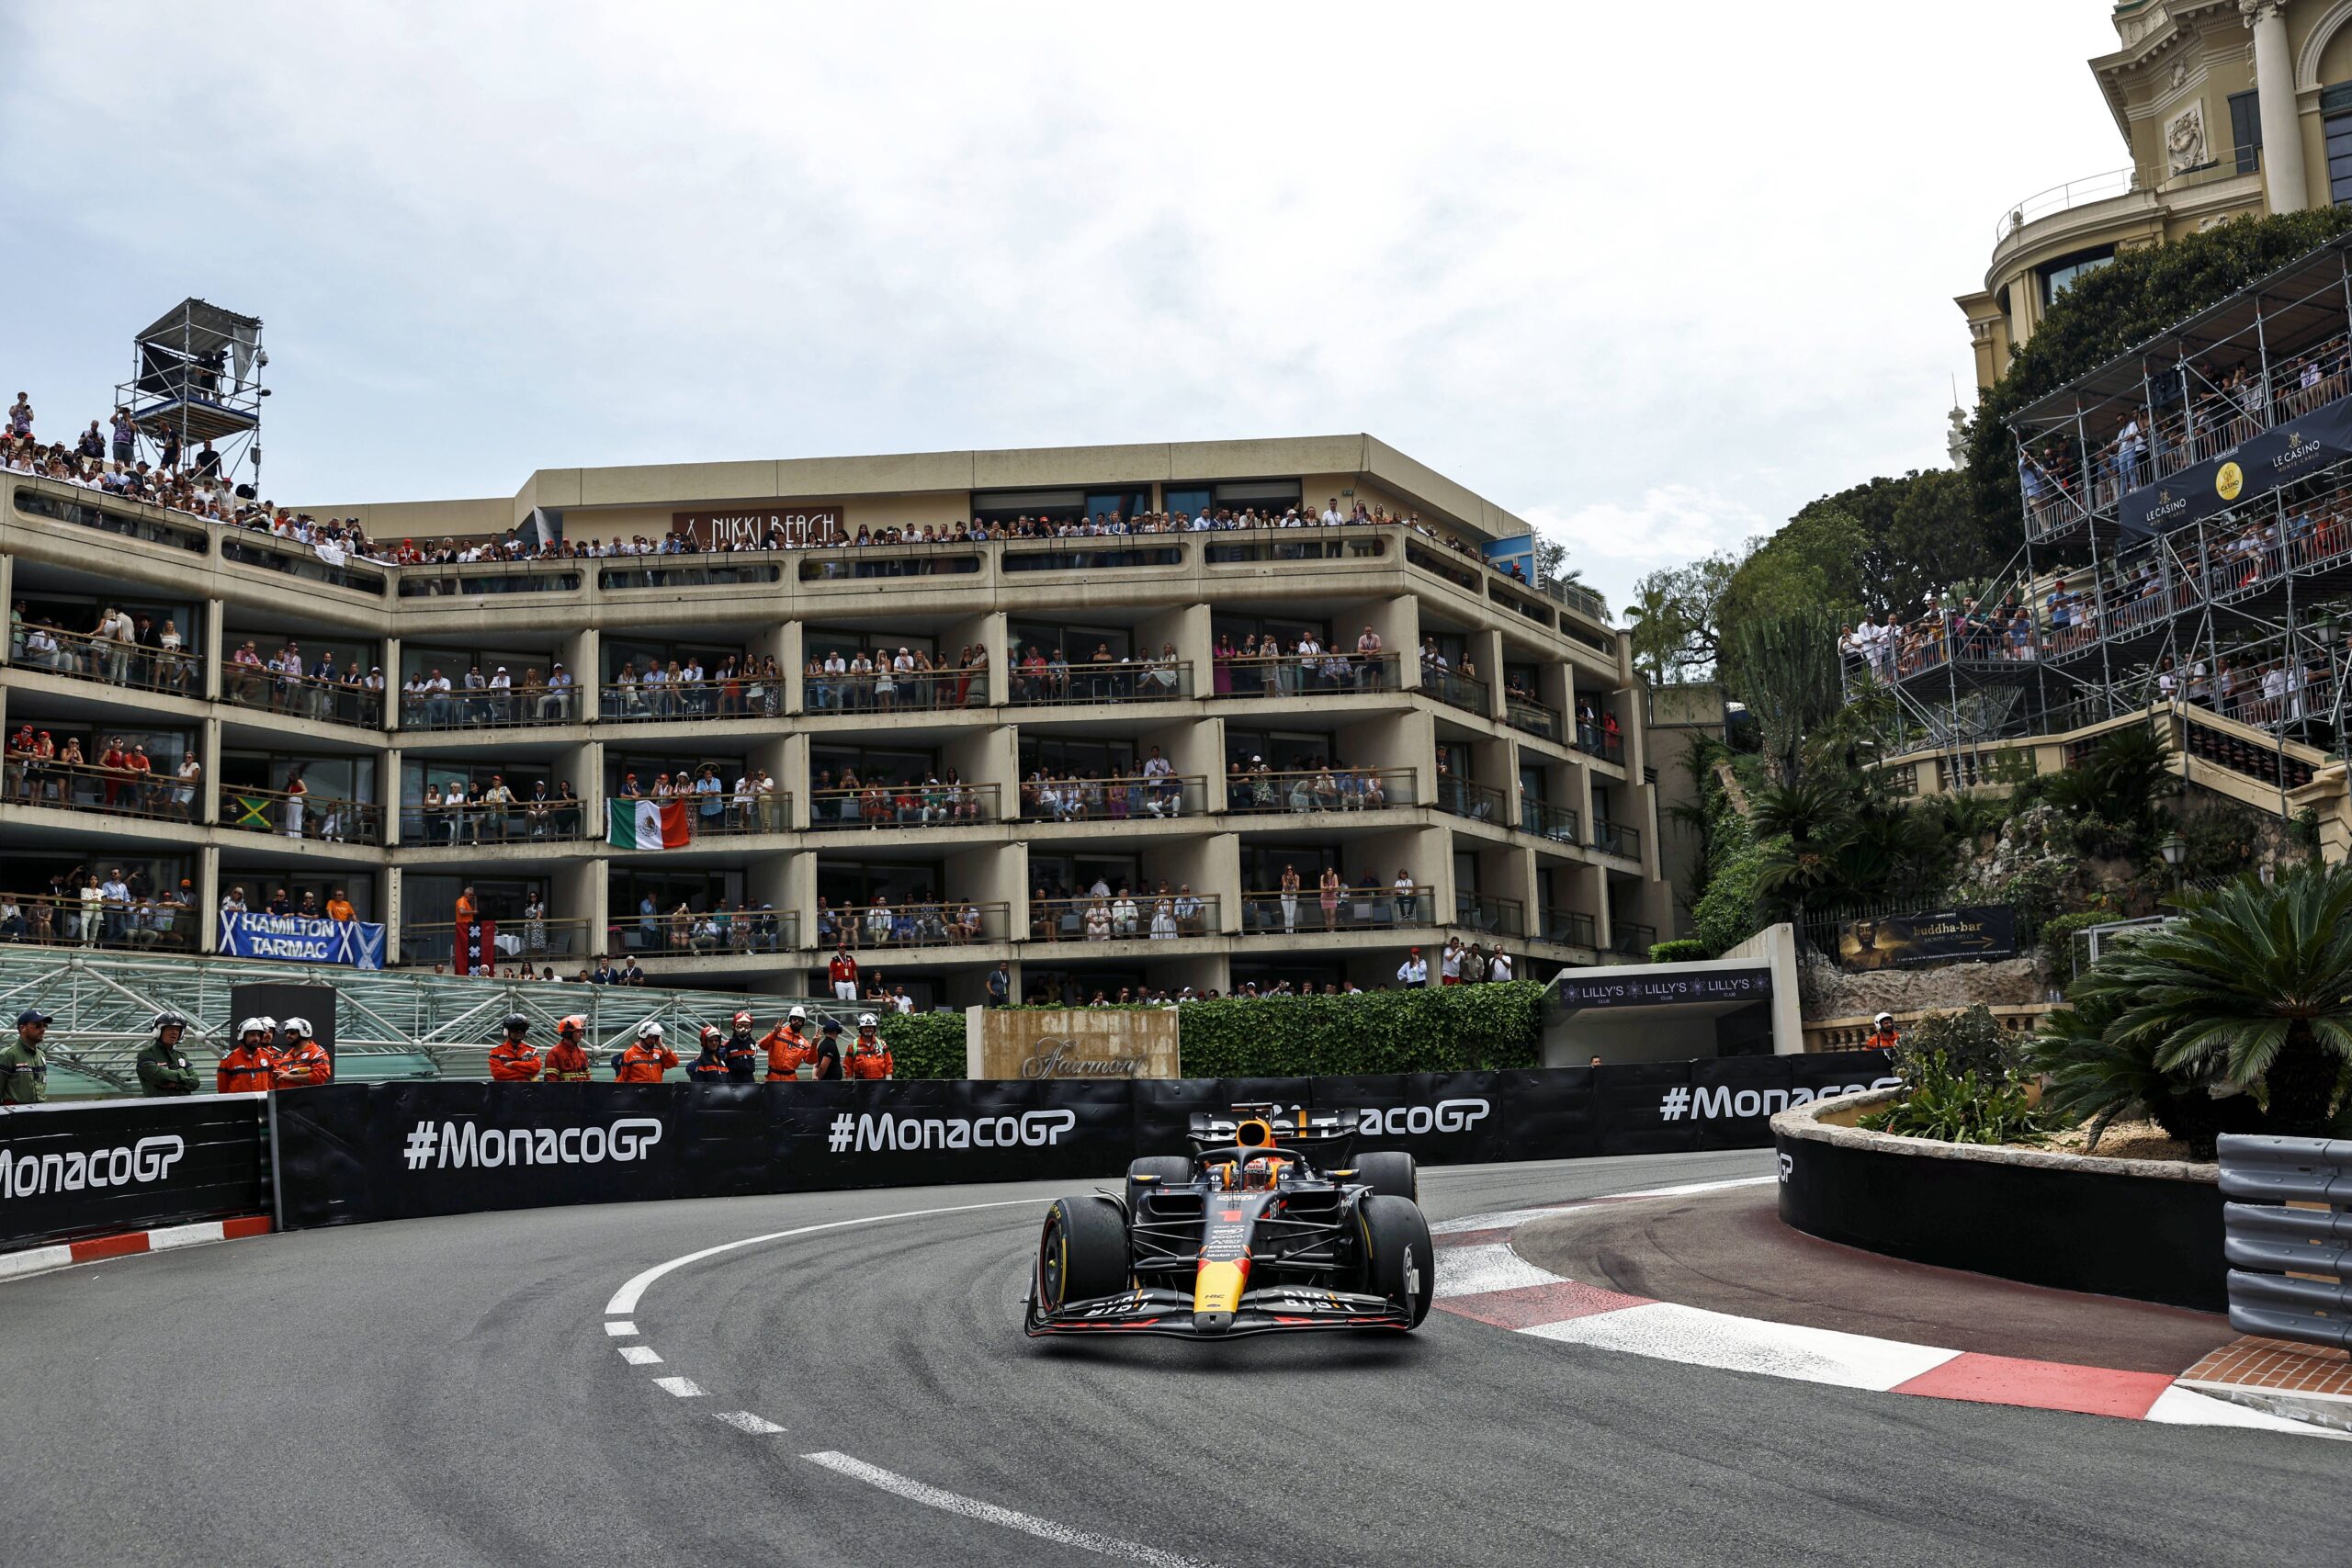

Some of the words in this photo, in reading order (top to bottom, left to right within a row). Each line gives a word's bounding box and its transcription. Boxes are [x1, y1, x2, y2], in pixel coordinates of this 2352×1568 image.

[2272, 456, 2283, 468] LE
[2284, 440, 2320, 462] CASINO
[2155, 498, 2187, 517] CASINO
[712, 516, 762, 549] NIKKI
[771, 513, 834, 543] BEACH
[241, 913, 334, 938] HAMILTON
[1913, 921, 1983, 936] buddha-bar
[249, 936, 329, 959] TARMAC
[1582, 986, 1624, 998] LILLY'S
[1645, 982, 1687, 995] LILLY'S
[1708, 978, 1750, 991] LILLY'S
[1360, 1098, 1490, 1135] acoGP
[828, 1109, 1076, 1153] #MonacoGP
[403, 1118, 662, 1170] #MonacoGP
[1217, 1210, 1243, 1223] 1
